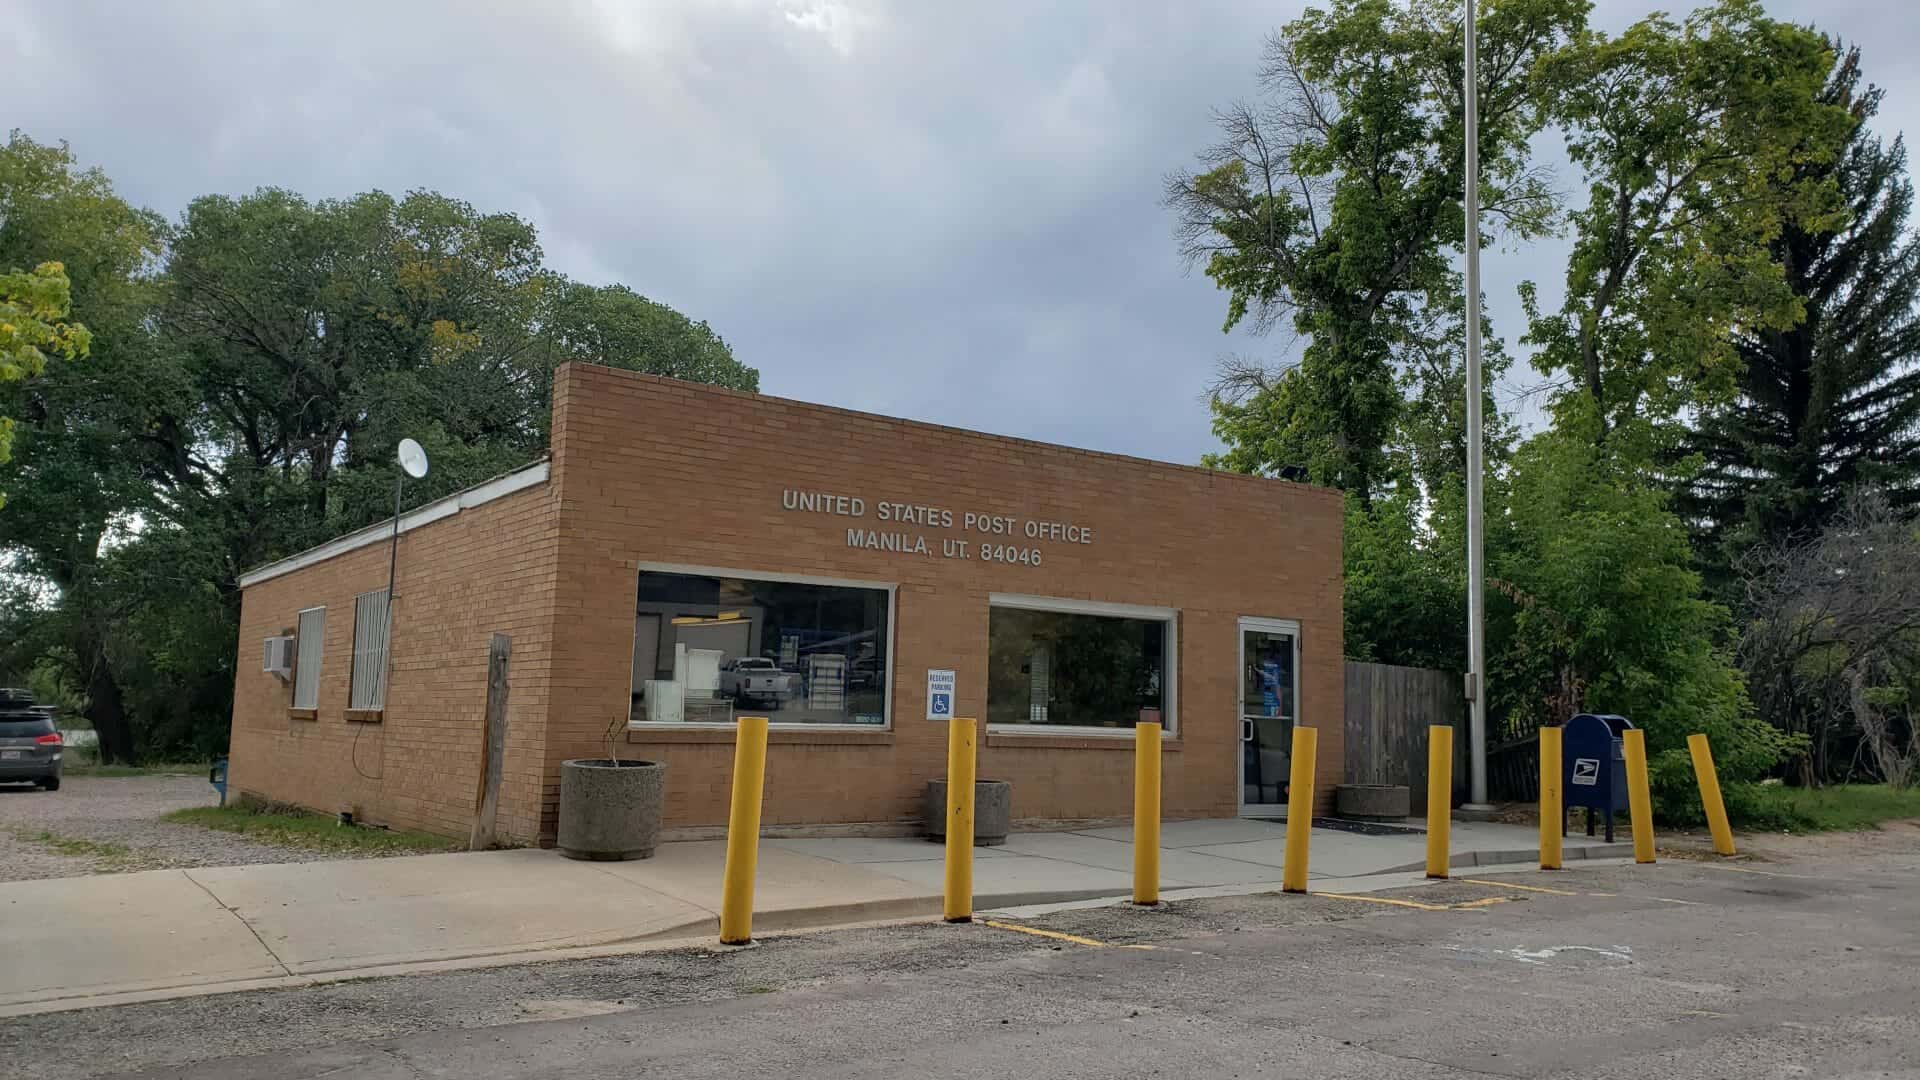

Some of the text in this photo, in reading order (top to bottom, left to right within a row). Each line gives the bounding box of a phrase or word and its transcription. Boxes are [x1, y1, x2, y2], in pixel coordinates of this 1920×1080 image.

[783, 489, 1092, 544] UNITED STATES POST OFFICE
[847, 528, 1041, 566] MANILA, UT. 84046
